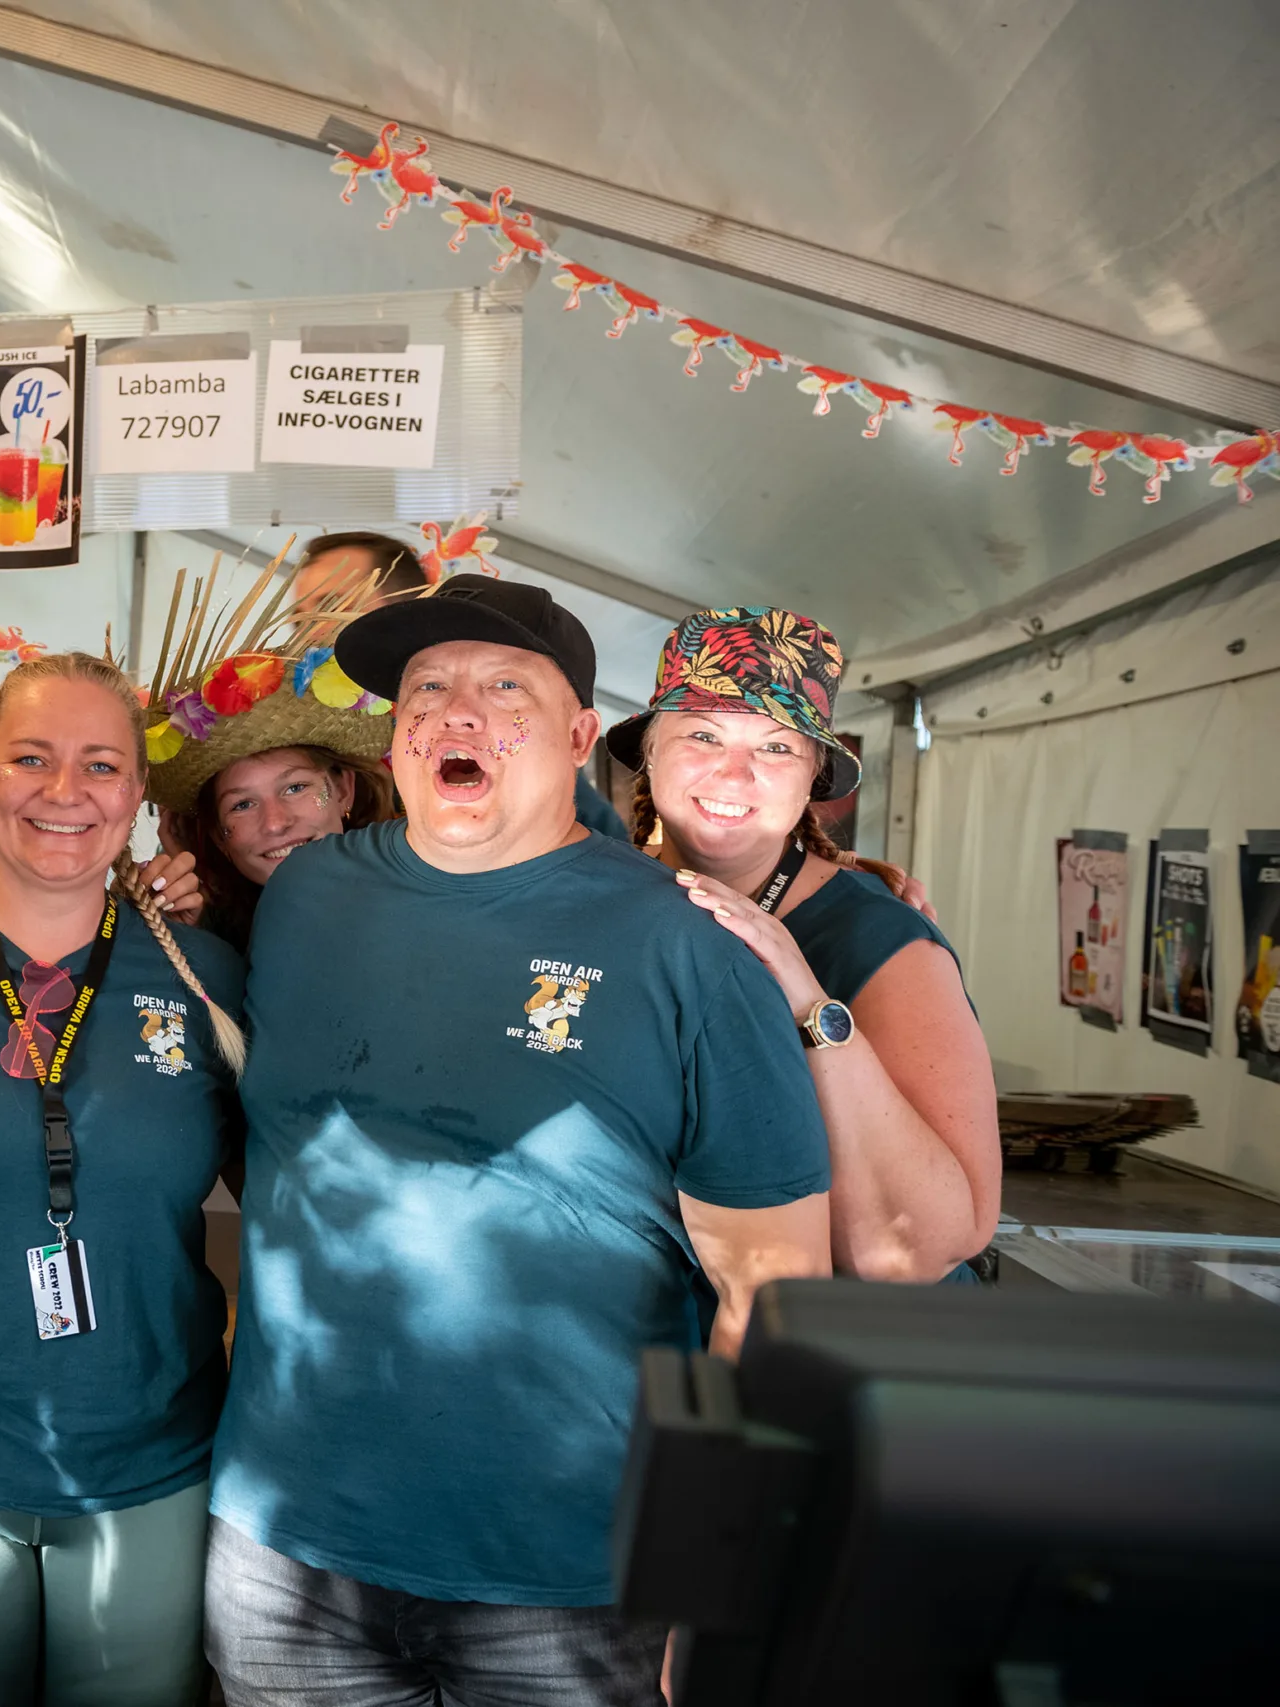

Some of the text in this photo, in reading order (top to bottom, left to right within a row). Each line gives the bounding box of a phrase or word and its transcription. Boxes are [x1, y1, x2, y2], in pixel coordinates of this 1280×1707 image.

[22, 351, 37, 360] ICE
[118, 373, 226, 395] Labamba
[290, 365, 420, 384] CIGARETTER
[12, 378, 62, 419] 50,-
[303, 389, 401, 407] SÆLGES I
[121, 415, 221, 439] 727907
[278, 412, 423, 432] INFO-VOGNEN
[760, 872, 789, 912] EN-AIR.DK
[101, 906, 116, 939] OPEN
[530, 959, 604, 982] OPEN AIR
[544, 974, 581, 988] VARDE
[0, 980, 22, 1015] OPEN
[133, 994, 187, 1016] OPEN AIR
[147, 1008, 176, 1019] VARDE
[49, 986, 95, 1083] OPEN AIR VARDE
[506, 1027, 584, 1050] WE ARE BACK
[526, 1039, 556, 1054] 2022
[134, 1054, 193, 1071] WE ARE BACK
[156, 1064, 178, 1077] 2022
[48, 1262, 63, 1310] CREW 2022
